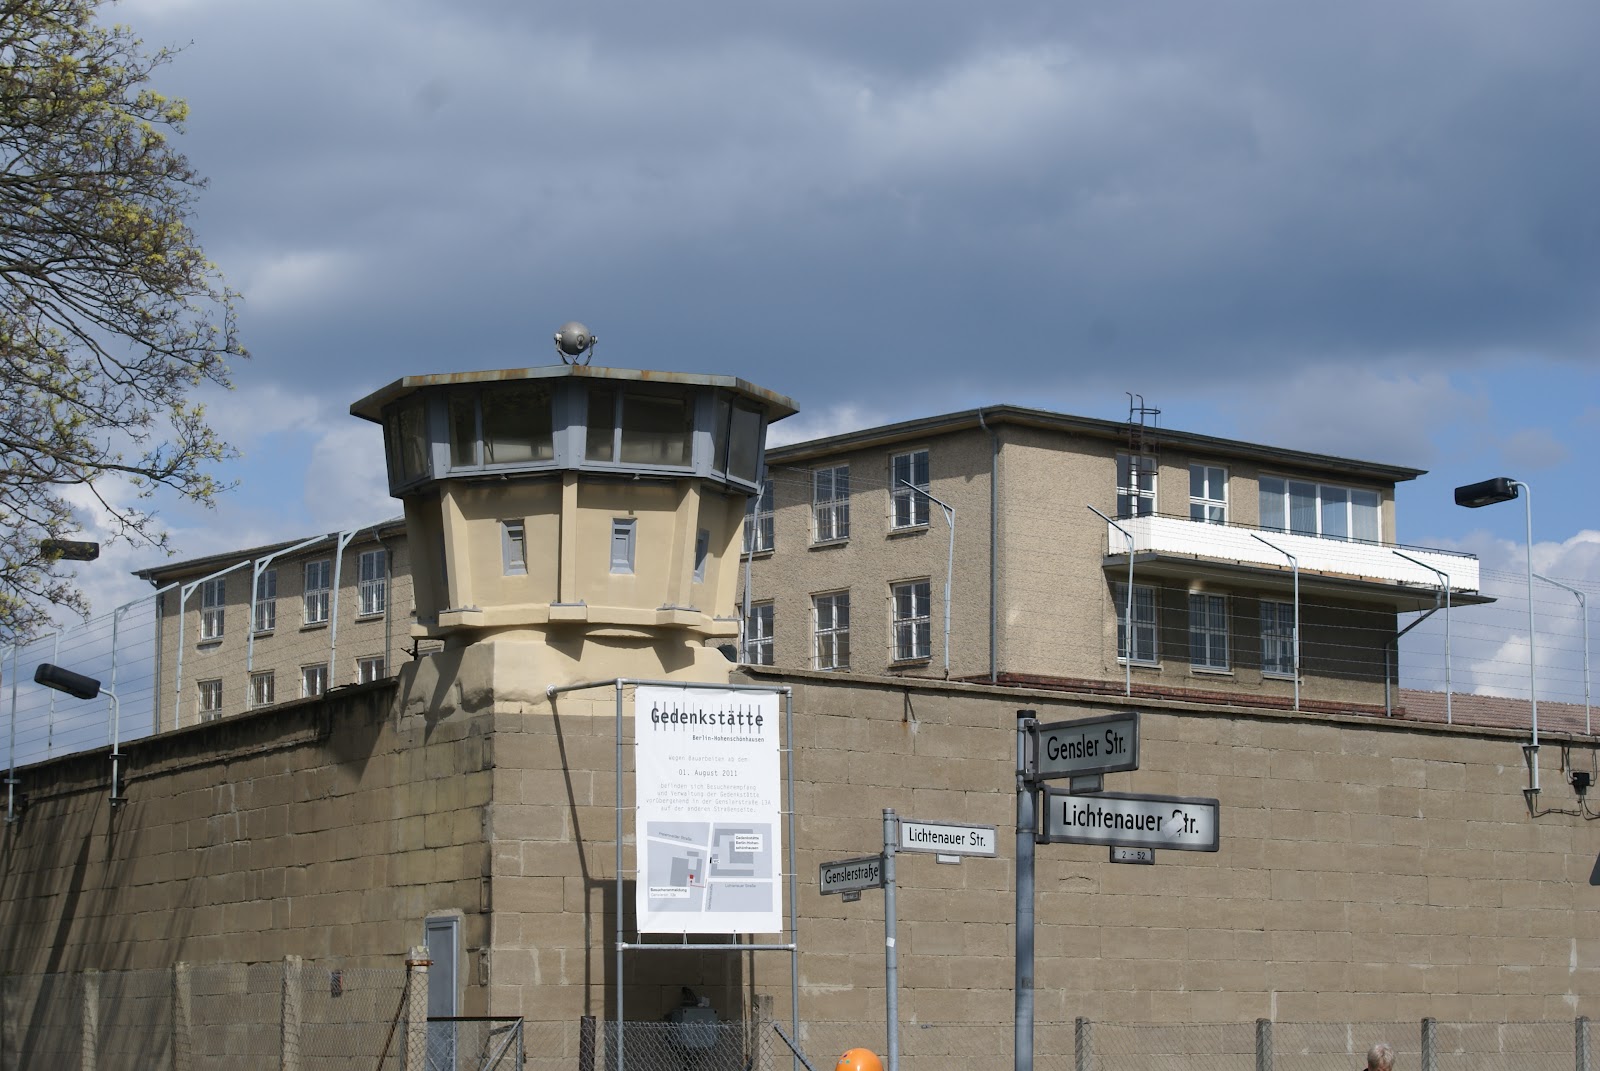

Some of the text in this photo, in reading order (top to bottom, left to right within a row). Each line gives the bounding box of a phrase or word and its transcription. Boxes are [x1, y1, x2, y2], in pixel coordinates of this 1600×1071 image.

[652, 708, 764, 726] Gedenkstätte
[1047, 729, 1126, 761] Gensler Str.
[694, 770, 718, 778] August
[1063, 801, 1163, 832] Lichtenauer
[909, 826, 986, 847] Lichtenauer Str.
[1122, 850, 1127, 859] 2
[1137, 851, 1146, 860] 52
[824, 864, 878, 884] Genslerstraße
